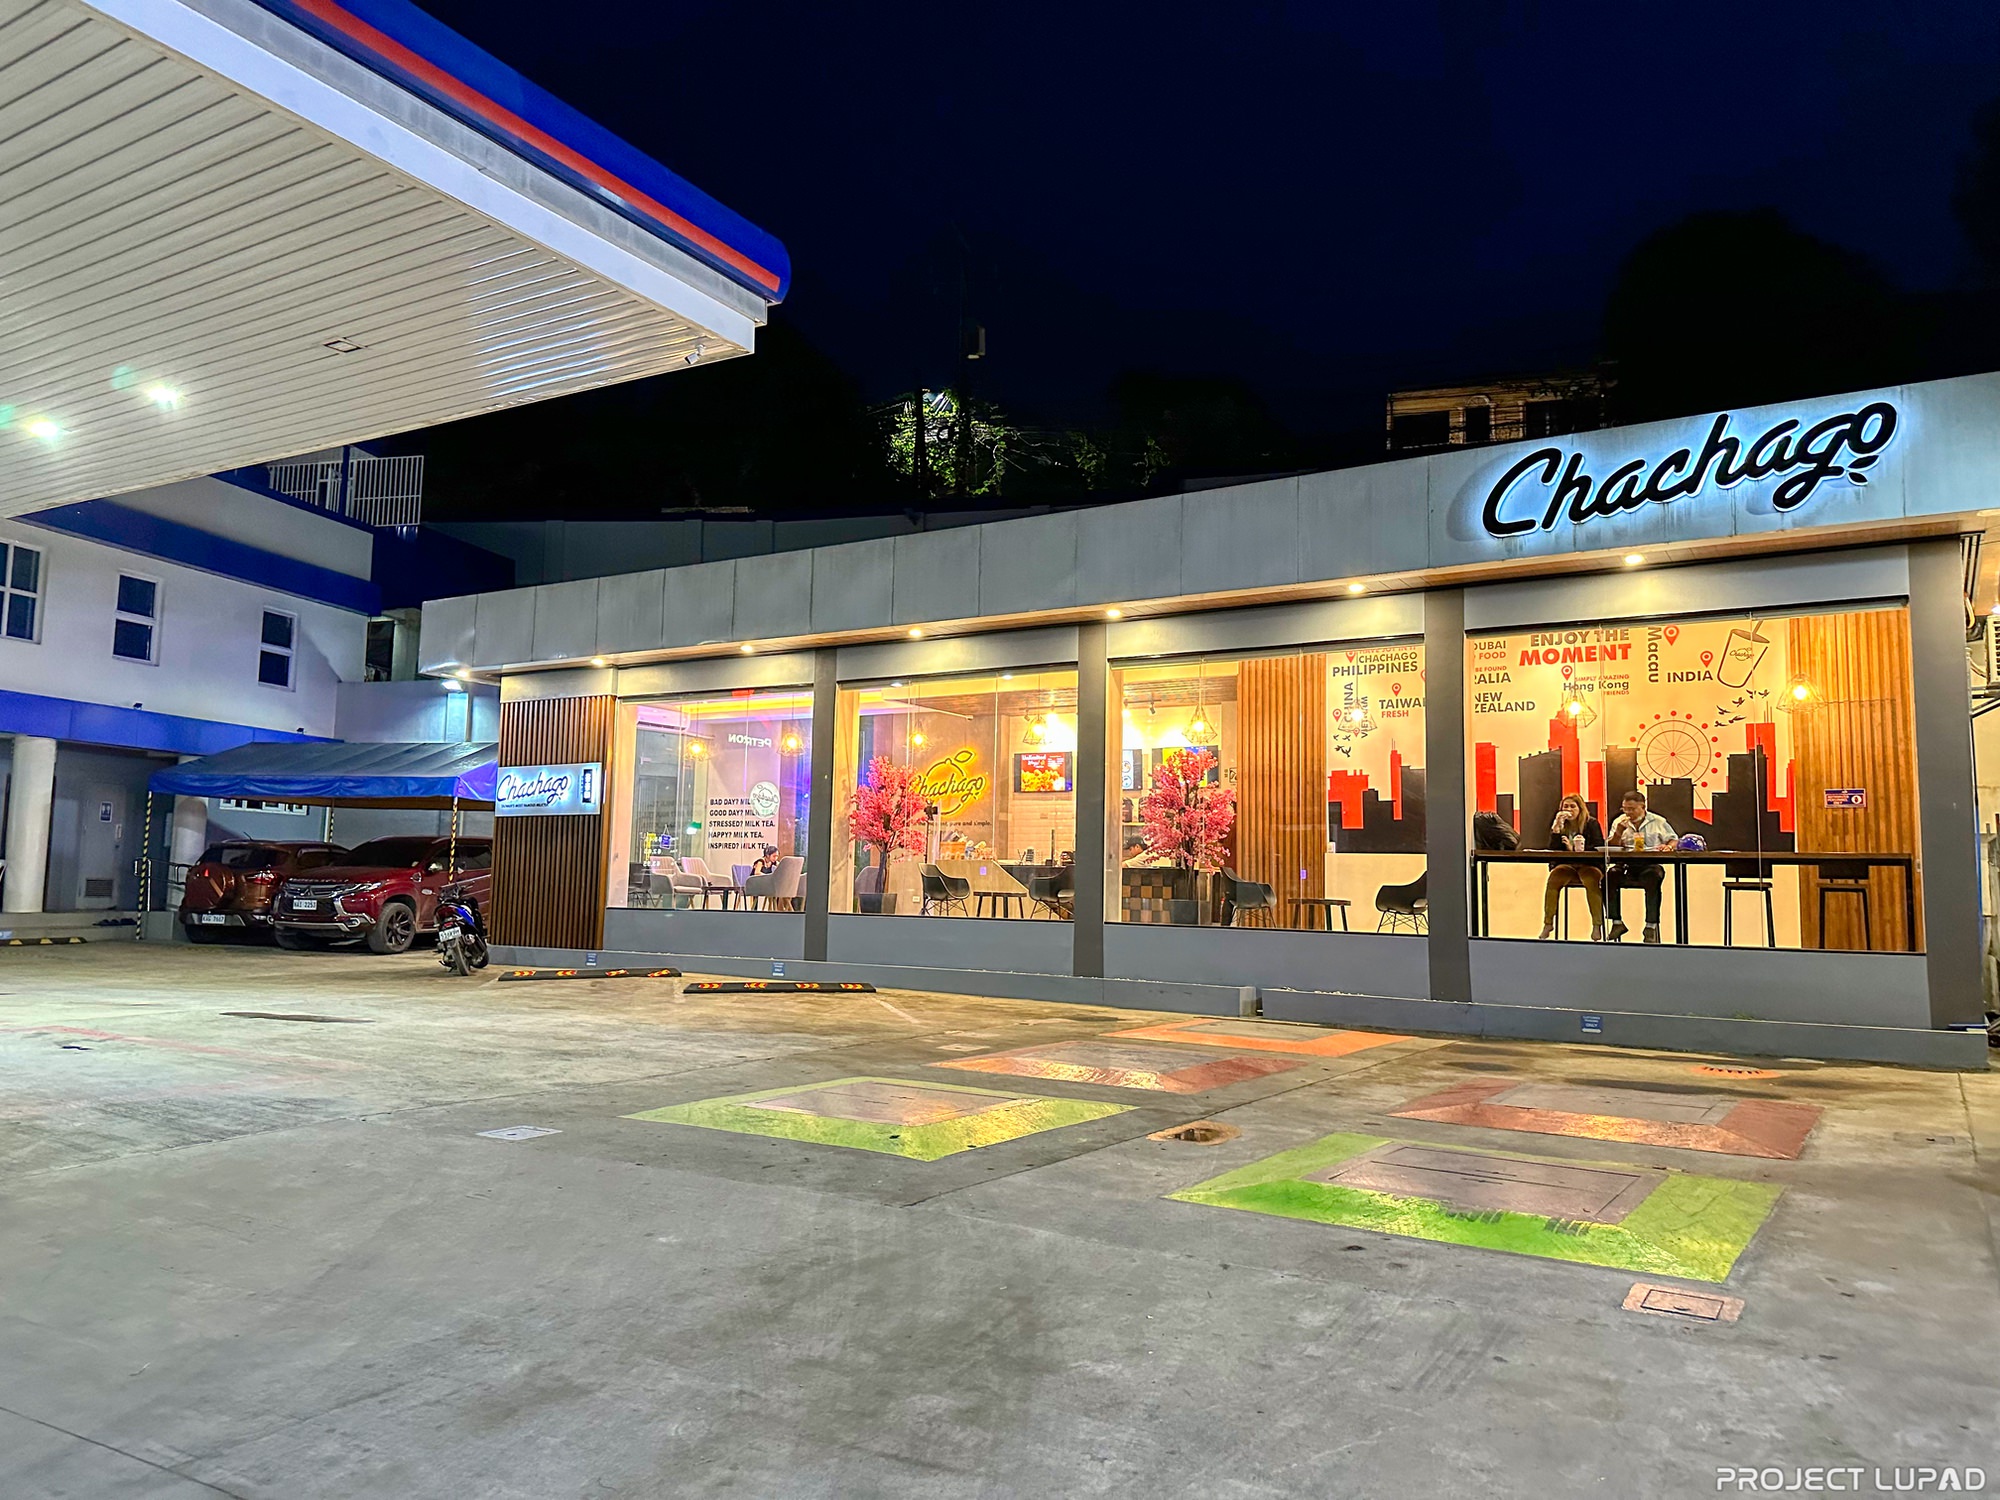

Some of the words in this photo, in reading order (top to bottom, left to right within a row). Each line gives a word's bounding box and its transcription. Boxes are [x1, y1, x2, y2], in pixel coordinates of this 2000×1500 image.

[1482, 402, 1899, 537] Chachago
[1531, 630, 1590, 647] ENJOY
[1594, 628, 1630, 643] THE
[1359, 651, 1418, 663] CHACHAGO
[1479, 651, 1507, 660] FOOD
[1519, 643, 1632, 667] MOMENT
[1648, 626, 1662, 683] Macau
[1332, 661, 1418, 677] PHILIPPINES
[1667, 670, 1714, 683] INDIA
[1563, 682, 1594, 692] Hong
[1599, 681, 1630, 690] Kong
[1475, 691, 1503, 702] NEW
[1379, 697, 1426, 710] TAIWA
[1475, 701, 1536, 713] ZEALAND
[1381, 710, 1409, 719] FRESH
[497, 771, 568, 805] Chachago
